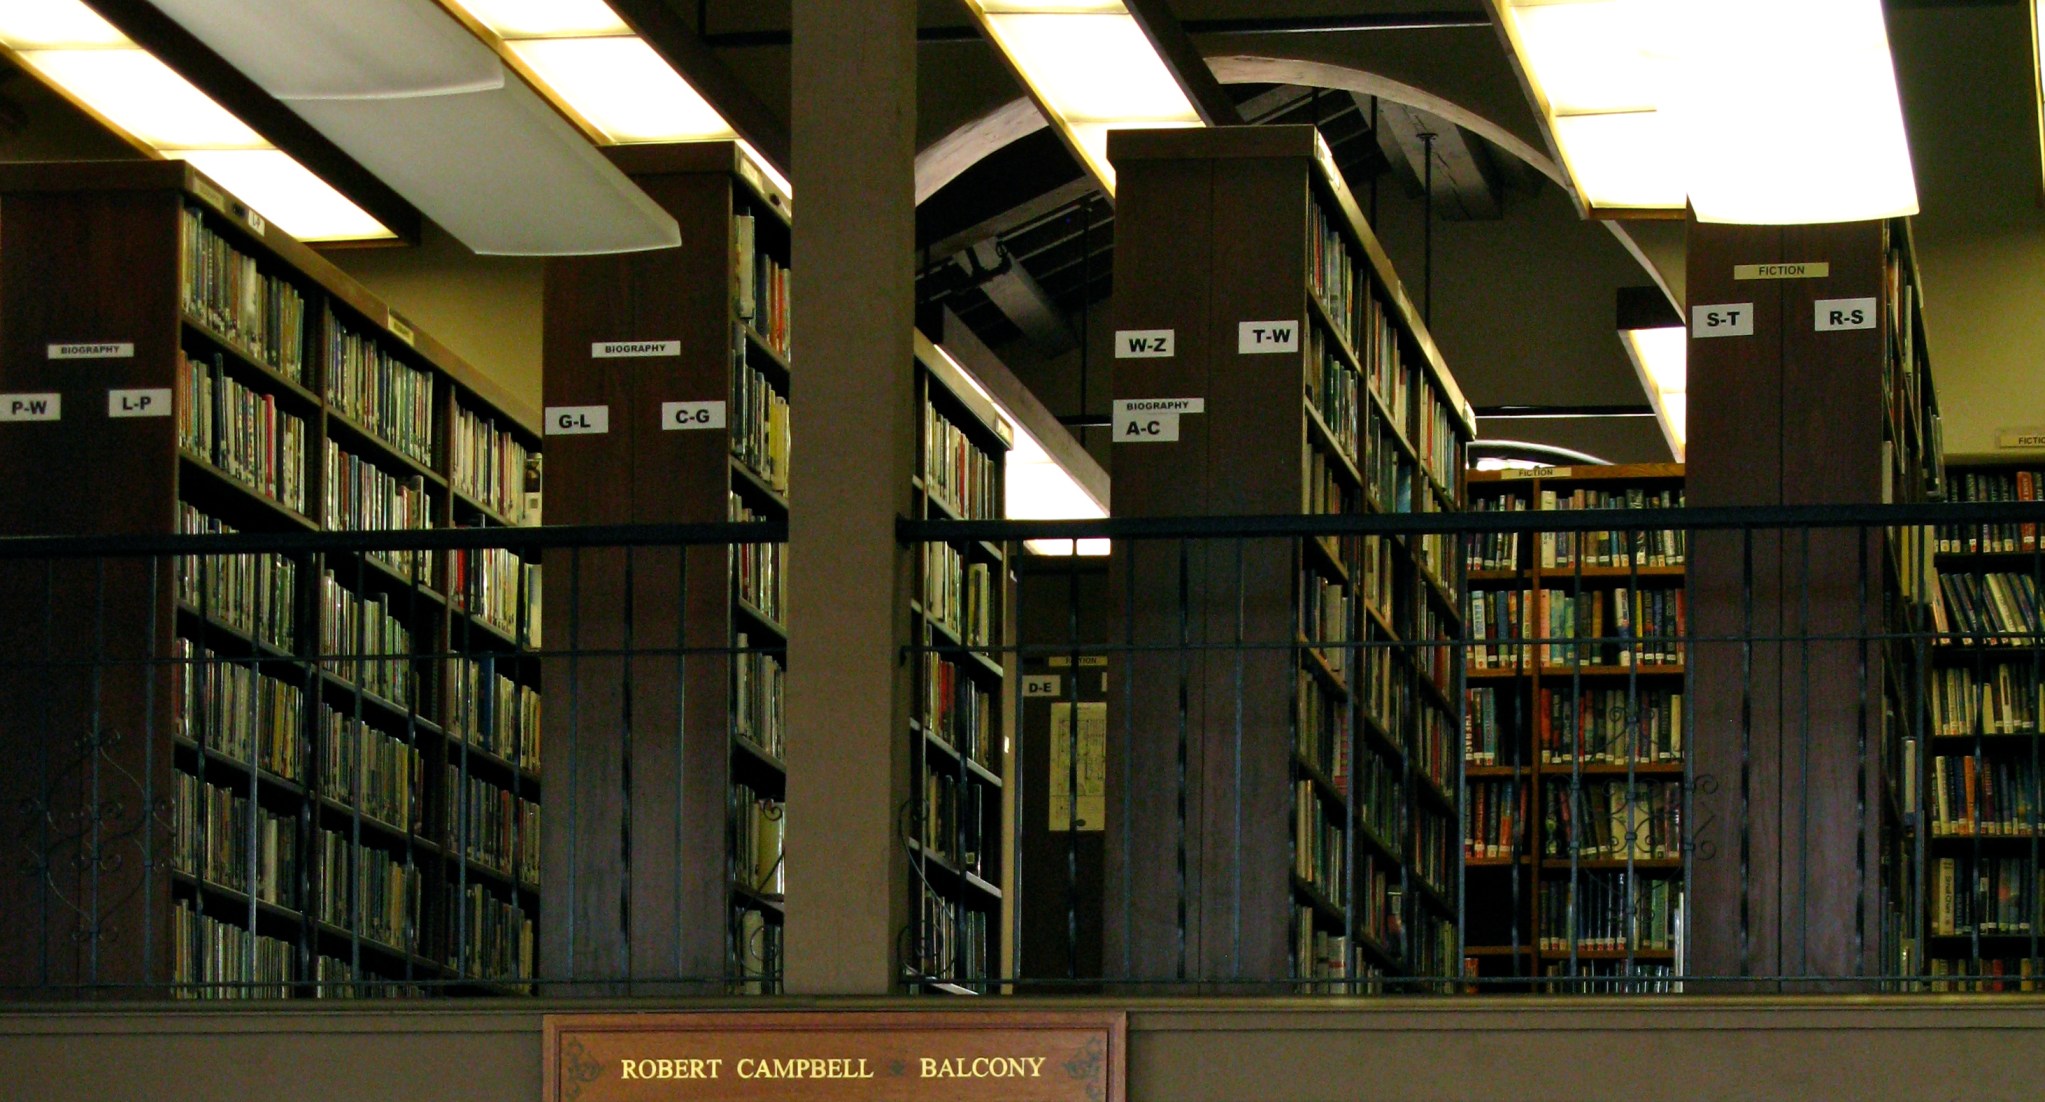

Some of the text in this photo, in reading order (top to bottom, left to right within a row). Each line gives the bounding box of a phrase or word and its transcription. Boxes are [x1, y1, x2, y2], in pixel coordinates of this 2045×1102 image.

[1758, 265, 1805, 276] FICTION
[1706, 311, 1741, 327] S-T
[1829, 309, 1864, 325] R-S
[1252, 328, 1291, 344] T-W
[60, 345, 120, 355] BIOGRAPHY
[604, 343, 666, 353] BIOGRAPHY
[1128, 337, 1167, 353] W-Z
[11, 400, 48, 416] P-W
[122, 395, 152, 411] L-P
[1126, 401, 1189, 411] BIOGRAPHY
[558, 413, 592, 429] G-L
[675, 408, 710, 424] C-G
[1125, 420, 1161, 436] A-C
[1518, 468, 1554, 477] FICTION
[1065, 657, 1097, 665] FTION
[1028, 682, 1052, 694] D-E
[620, 1057, 1046, 1079] ROBERT CAMPBELL BALCONY
